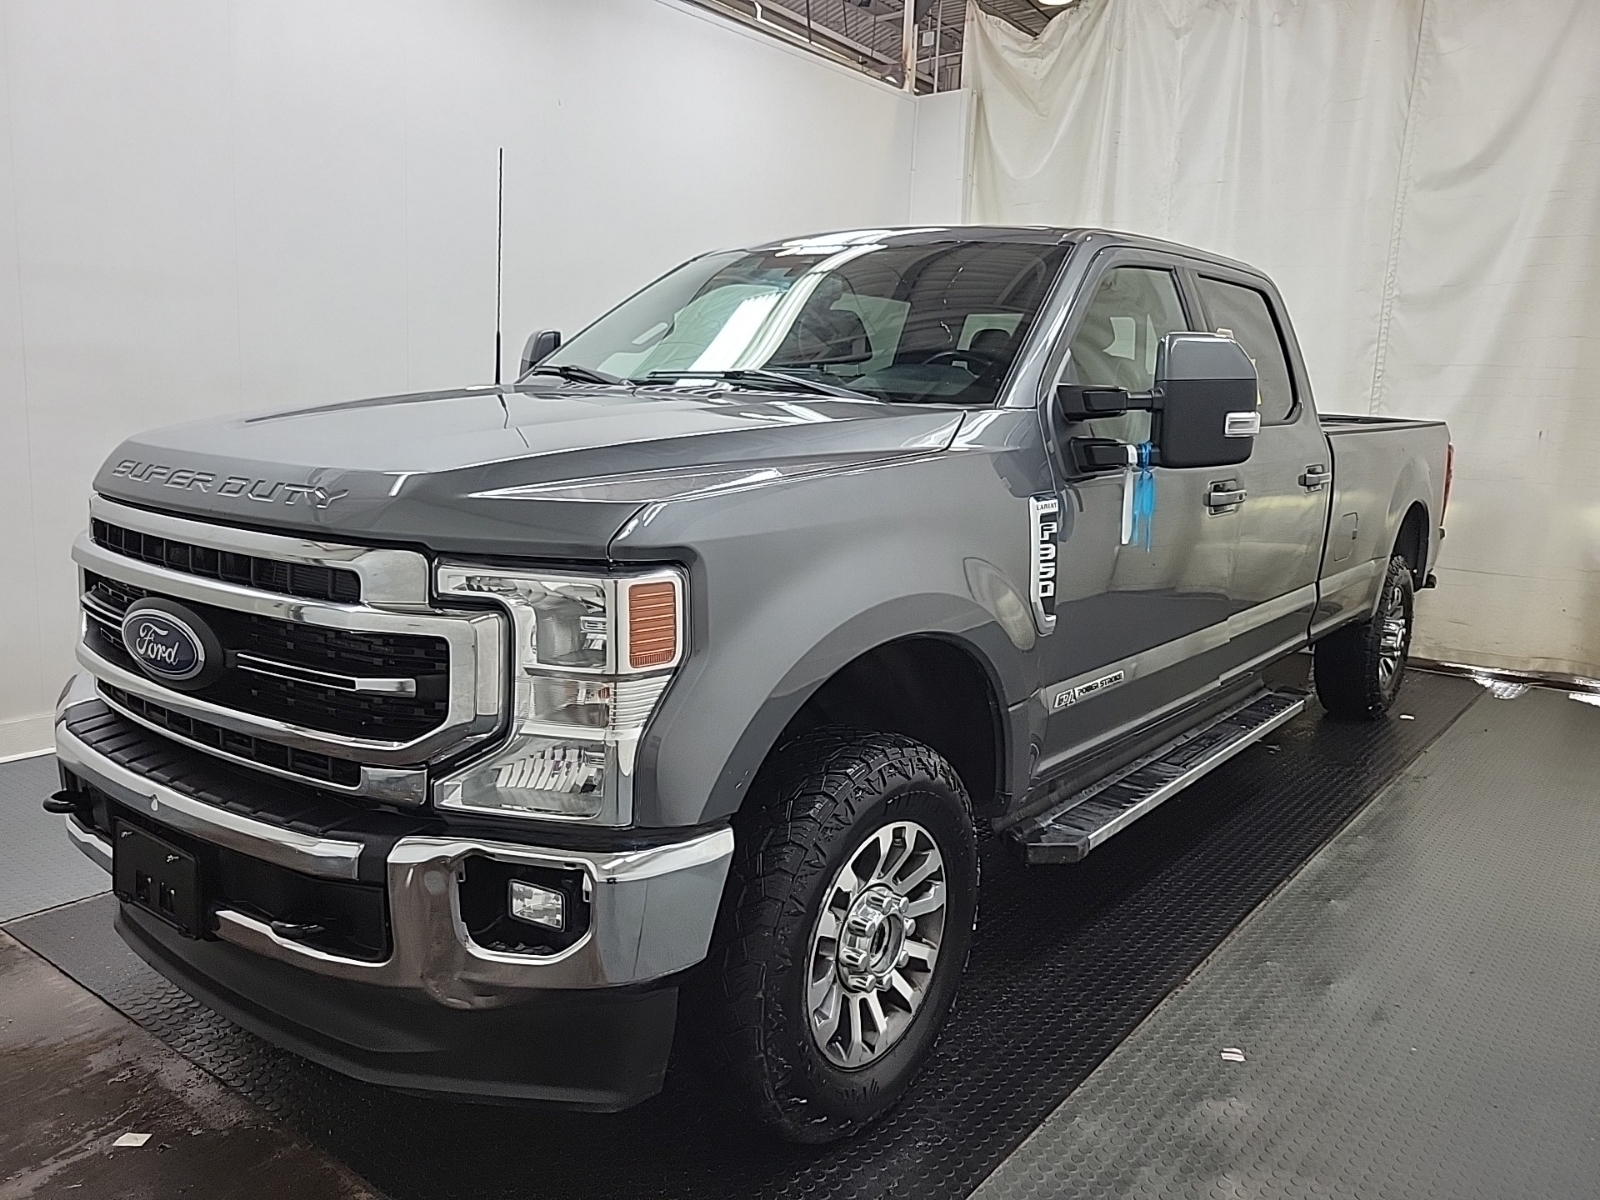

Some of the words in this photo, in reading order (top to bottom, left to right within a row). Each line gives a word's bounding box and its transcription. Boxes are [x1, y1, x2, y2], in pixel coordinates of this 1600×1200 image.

[112, 459, 216, 493] SUPER
[217, 475, 350, 509] DUTY
[136, 622, 180, 666] Ford
